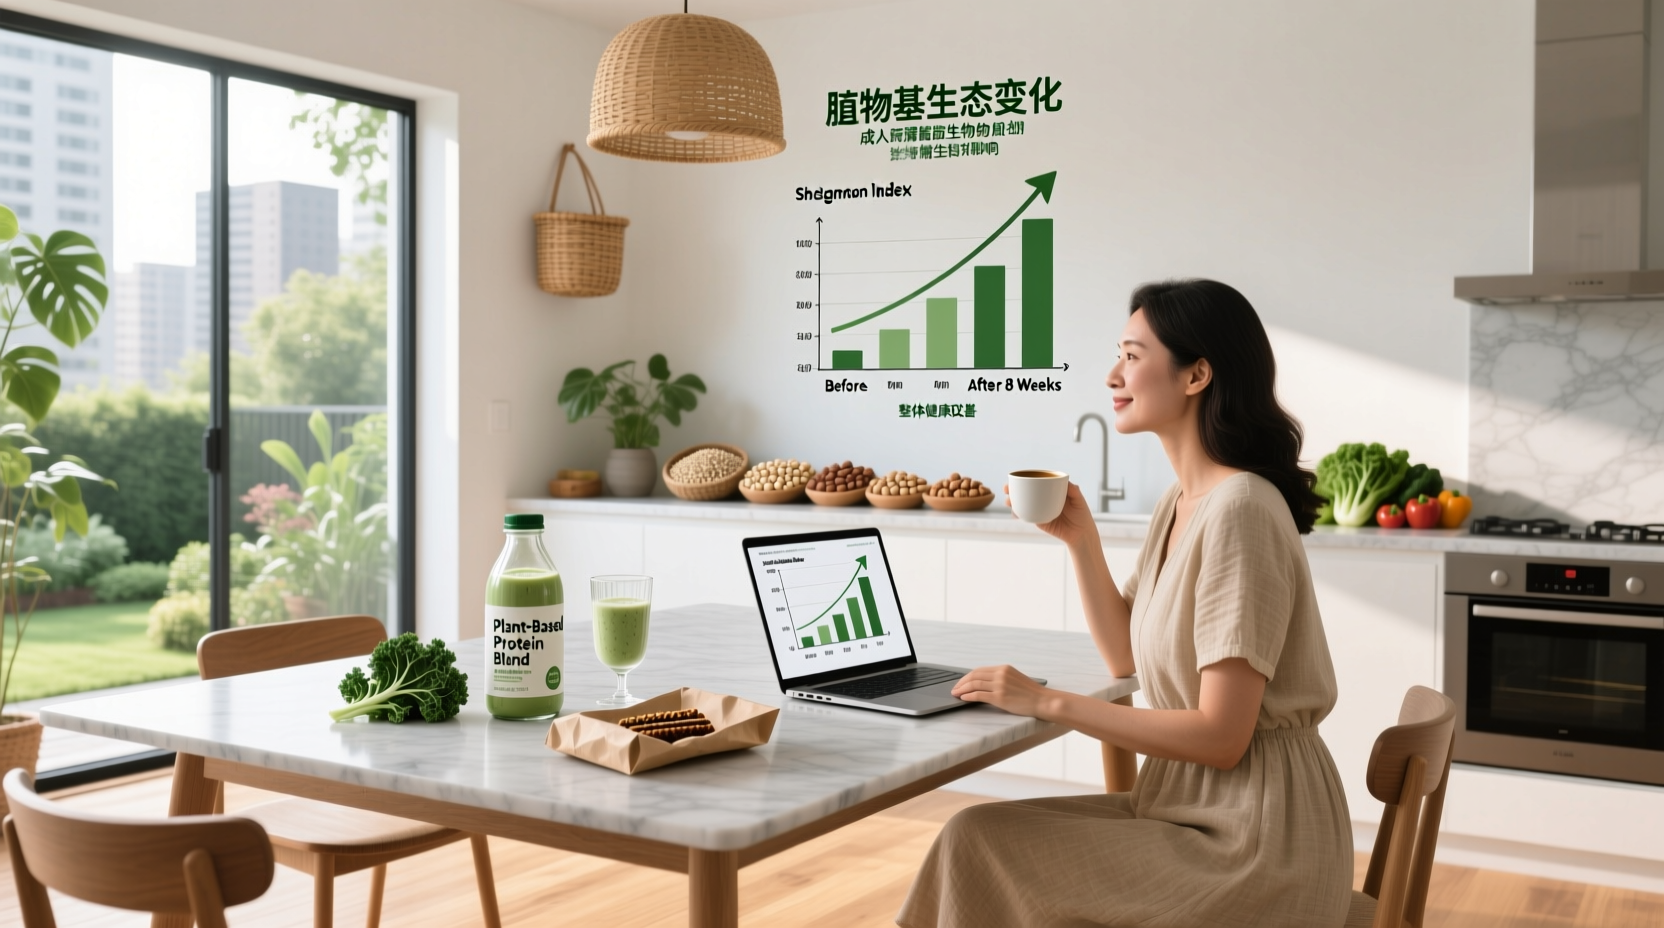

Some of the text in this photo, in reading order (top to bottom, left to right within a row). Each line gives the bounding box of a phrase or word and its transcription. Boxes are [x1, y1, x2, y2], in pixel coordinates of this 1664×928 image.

[871, 181, 912, 199] Index
[825, 378, 868, 393] Before
[967, 377, 1062, 392] After 8 Weeks
[493, 635, 544, 651] Protein
